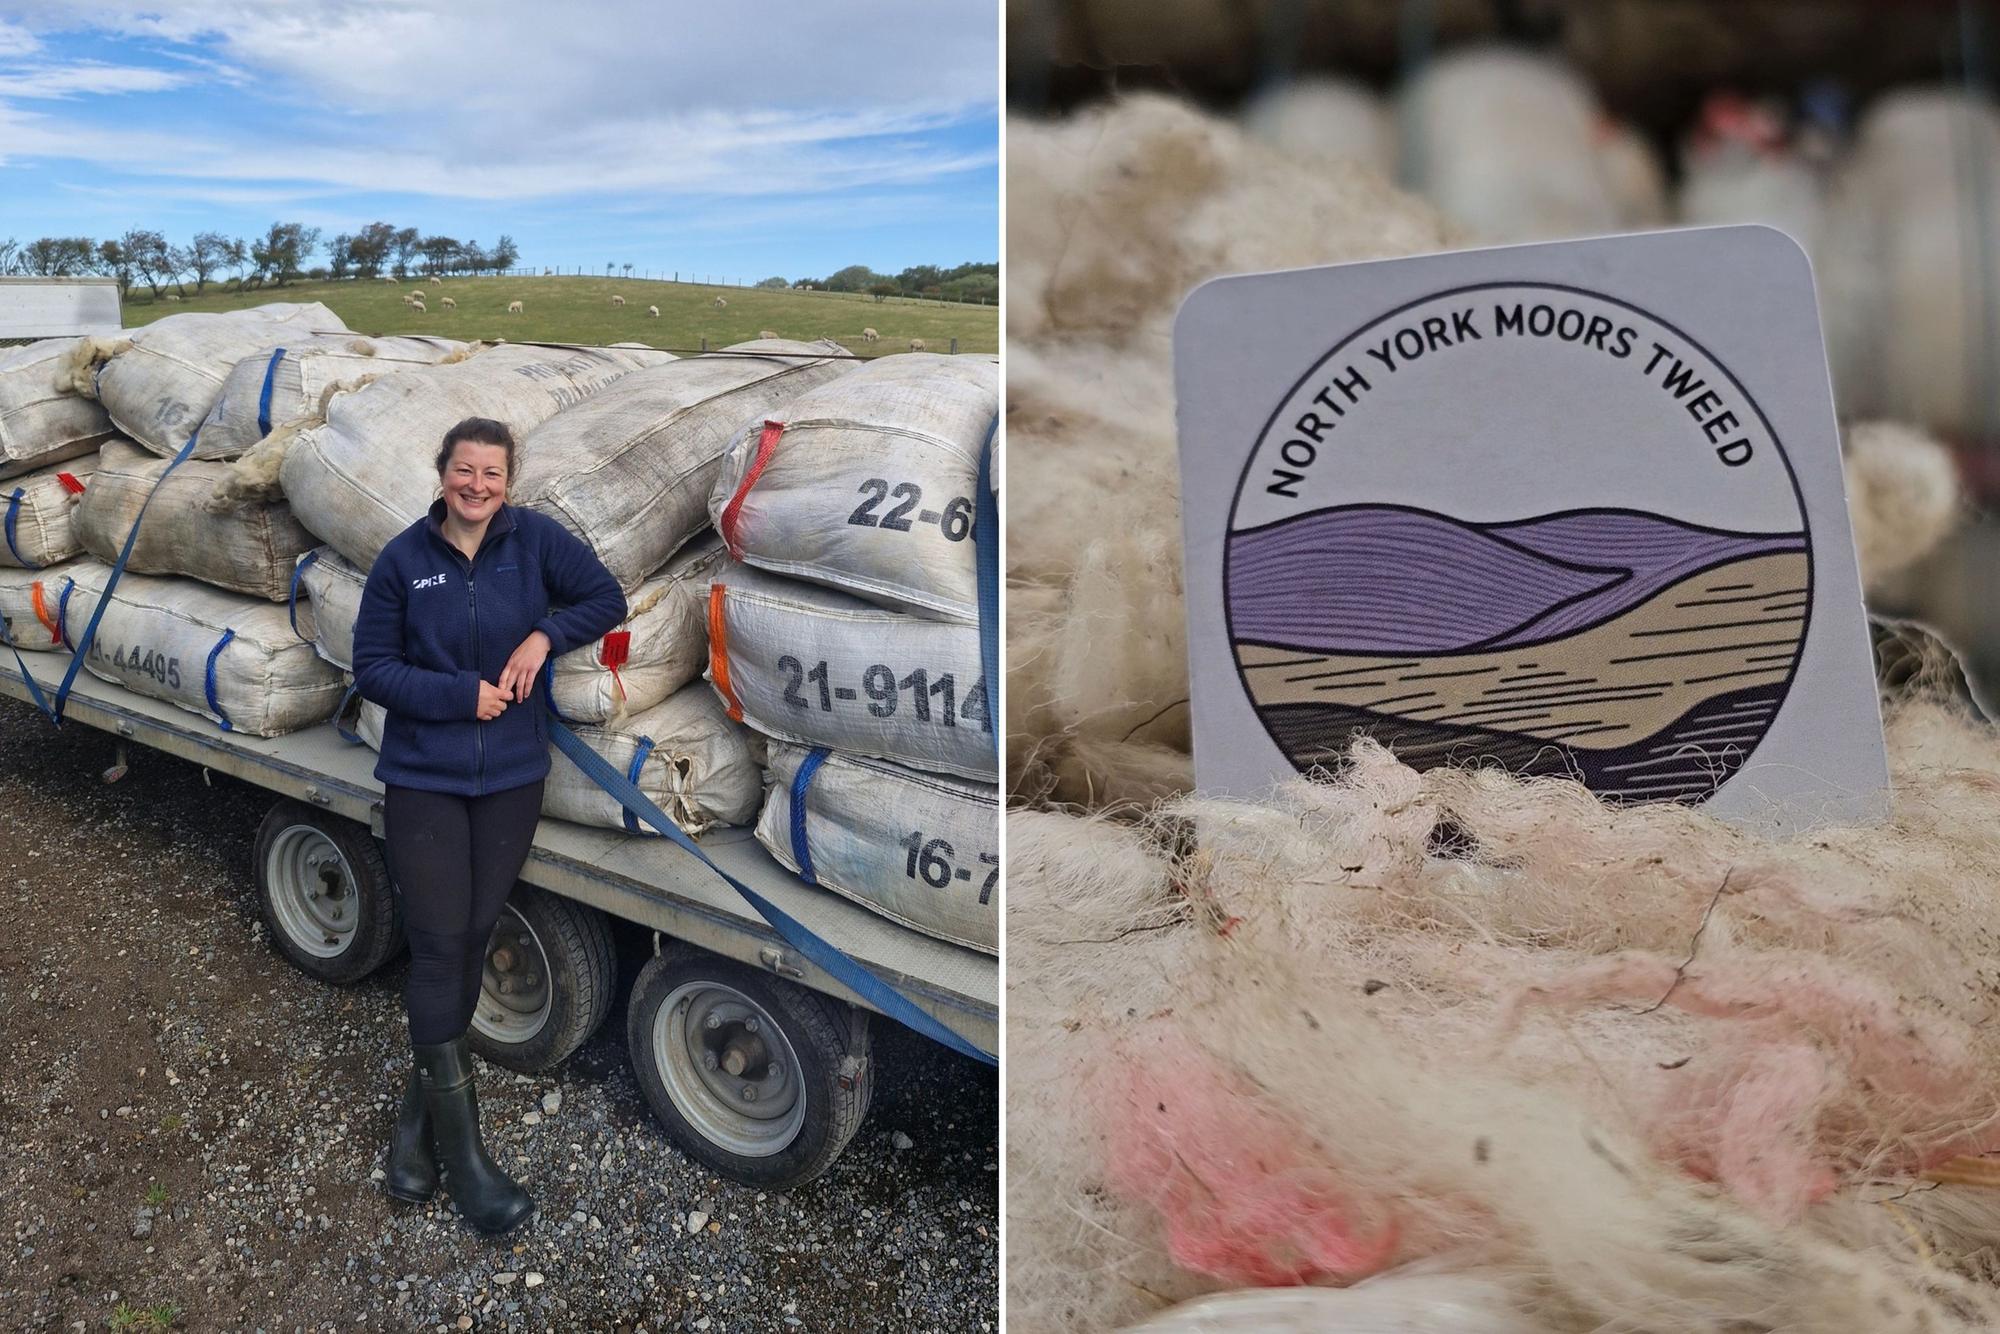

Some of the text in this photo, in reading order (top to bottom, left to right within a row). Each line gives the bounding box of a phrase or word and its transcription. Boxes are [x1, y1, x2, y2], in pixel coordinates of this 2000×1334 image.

[1265, 303, 1754, 499] NORTH YORK MOORS TWEED
[847, 477, 977, 542] 22-6
